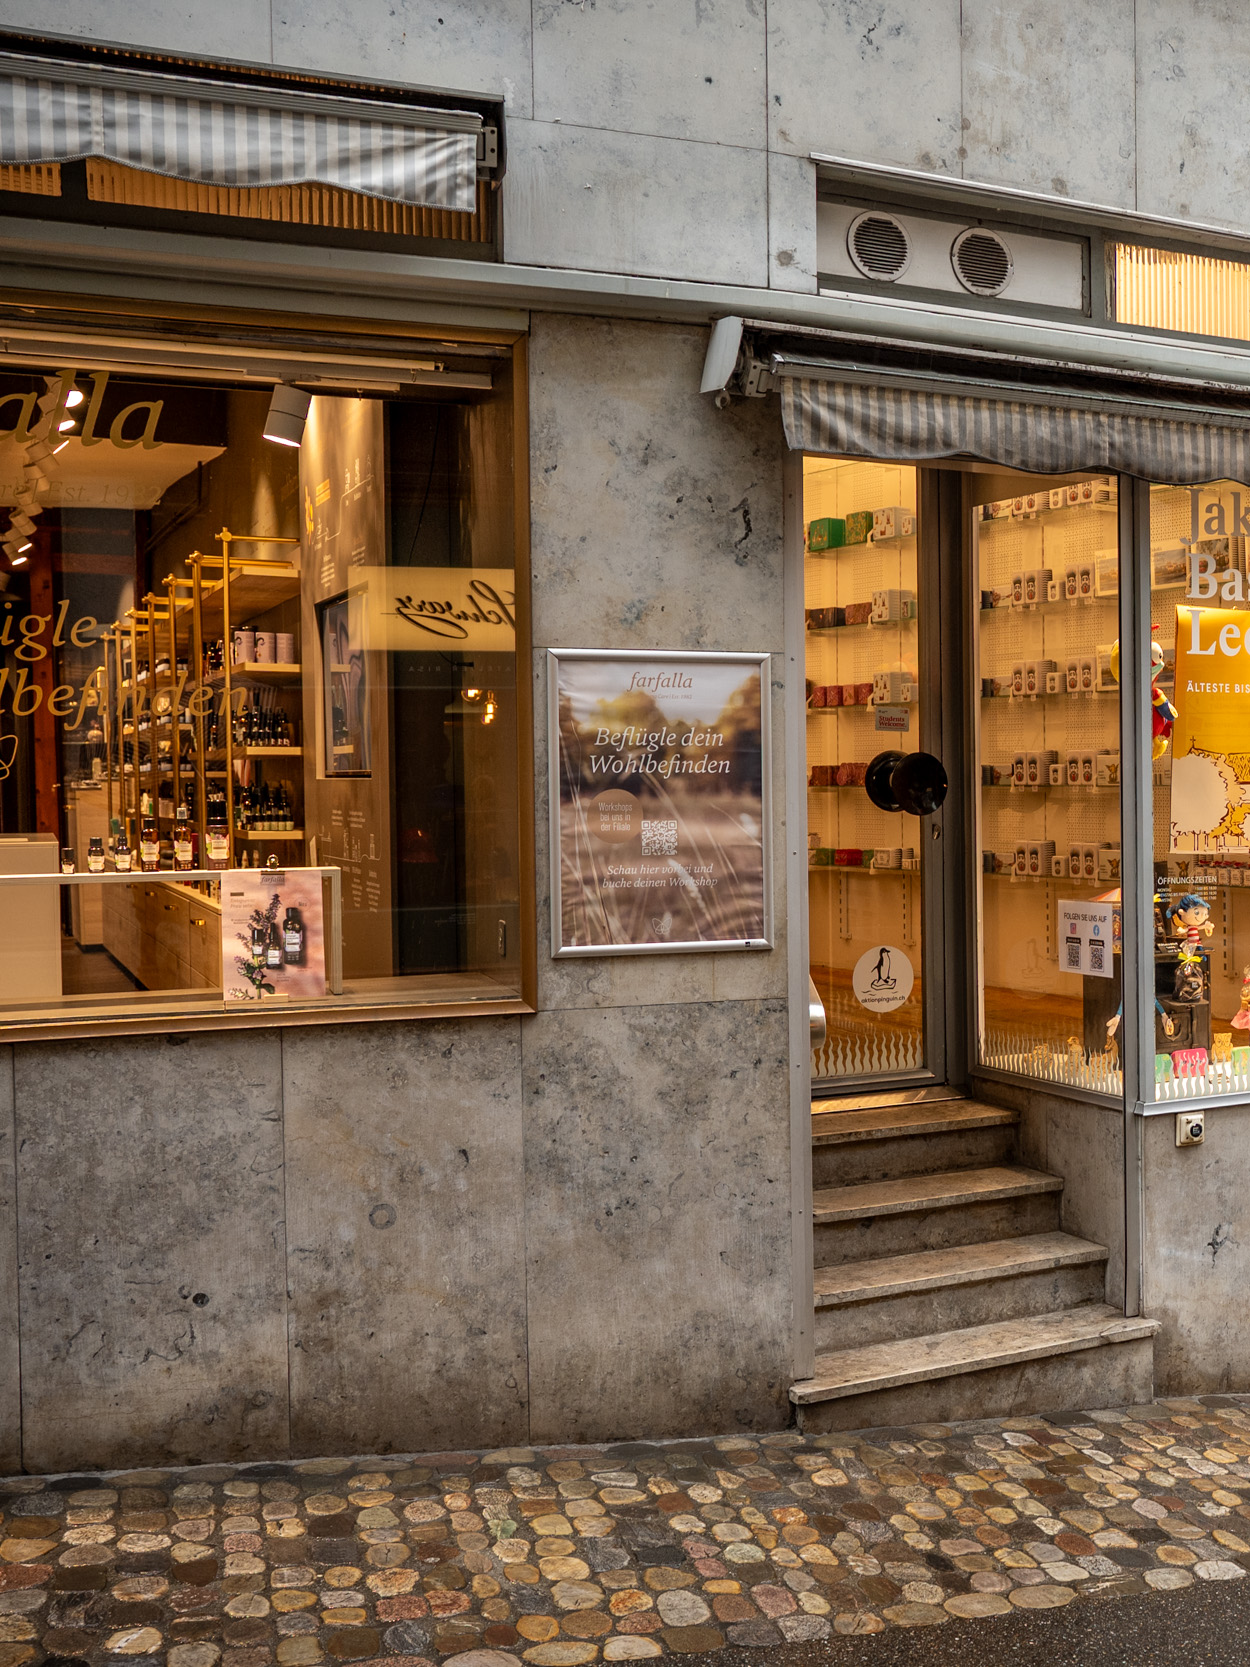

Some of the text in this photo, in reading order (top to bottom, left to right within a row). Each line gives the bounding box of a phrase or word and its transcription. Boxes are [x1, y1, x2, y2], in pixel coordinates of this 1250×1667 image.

[626, 671, 693, 692] farfalla
[1186, 679, 1230, 694] ÄLTESTE
[594, 726, 724, 752] Beflügle dein
[590, 753, 731, 779] Wohlbefinden
[598, 802, 633, 812] Workshops
[600, 813, 610, 821] bei
[624, 813, 631, 821] in
[600, 822, 631, 831] der Filiale
[607, 863, 714, 875] Schau hier vorbei und
[602, 877, 718, 889] buche deinen Workshop
[1157, 875, 1218, 885] ÖFFNUNGSZEITEN
[1063, 912, 1080, 921] FOLGEN
[1088, 914, 1097, 922] UNS
[1098, 915, 1107, 923] AUF
[860, 995, 906, 1004] aktionpinguin.ch
